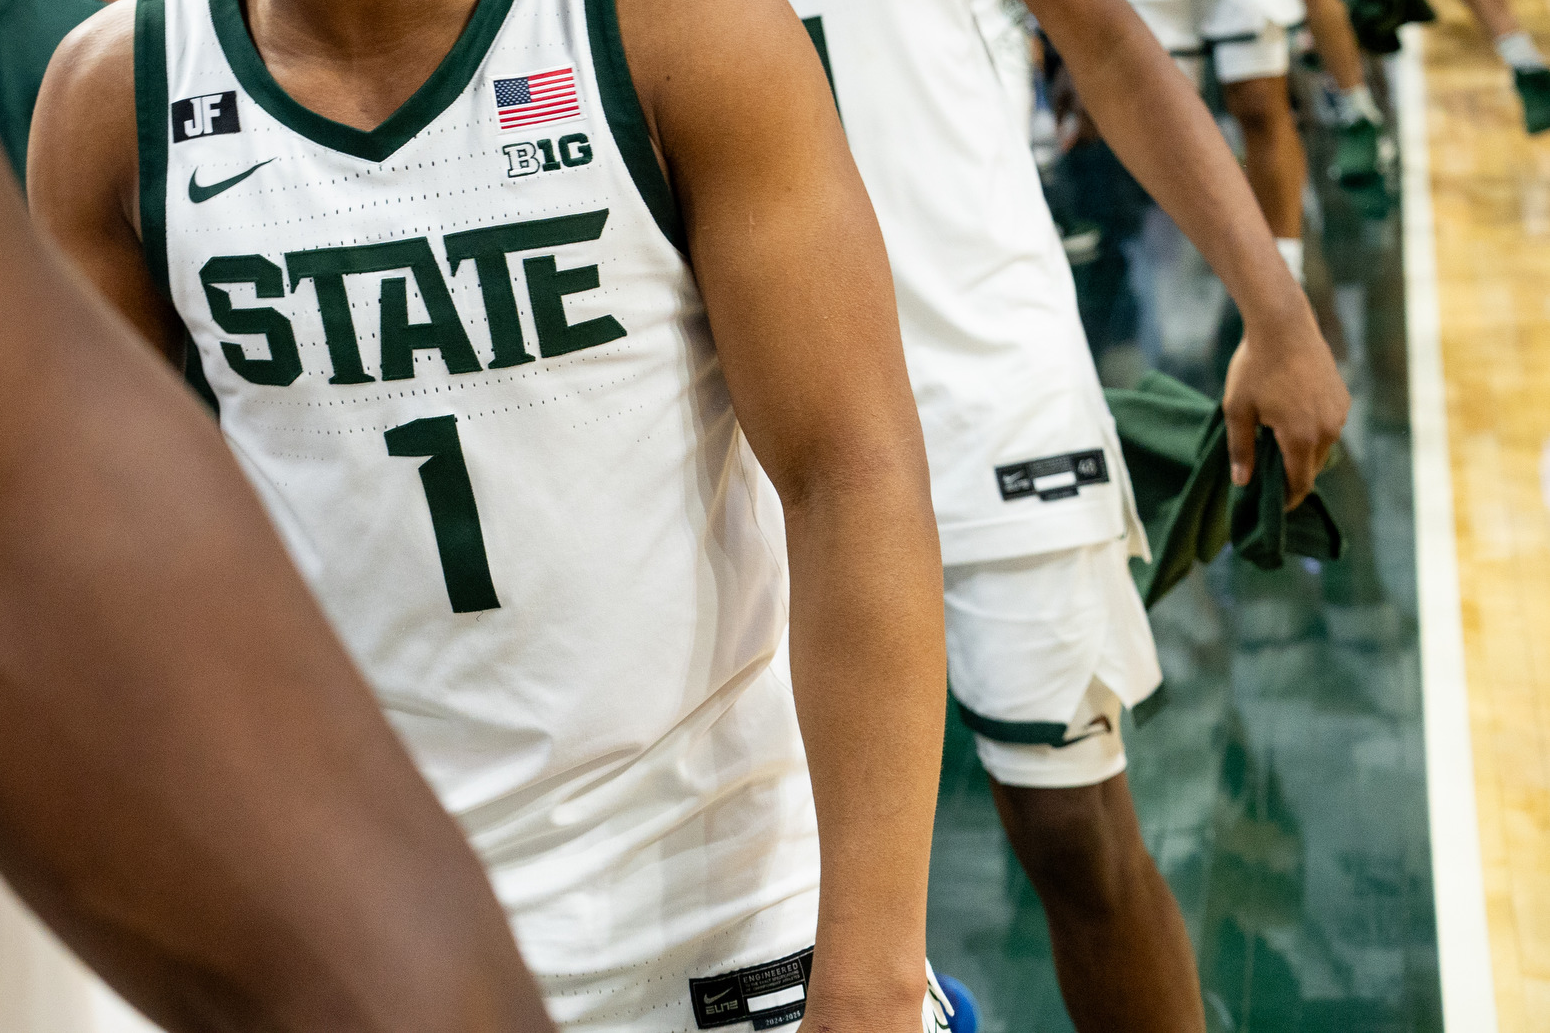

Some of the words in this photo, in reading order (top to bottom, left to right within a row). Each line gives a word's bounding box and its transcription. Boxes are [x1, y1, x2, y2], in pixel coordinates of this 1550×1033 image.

[184, 94, 223, 138] JF
[198, 207, 628, 387] STATE
[383, 413, 502, 614] 1
[743, 962, 799, 984] ENGINEERED
